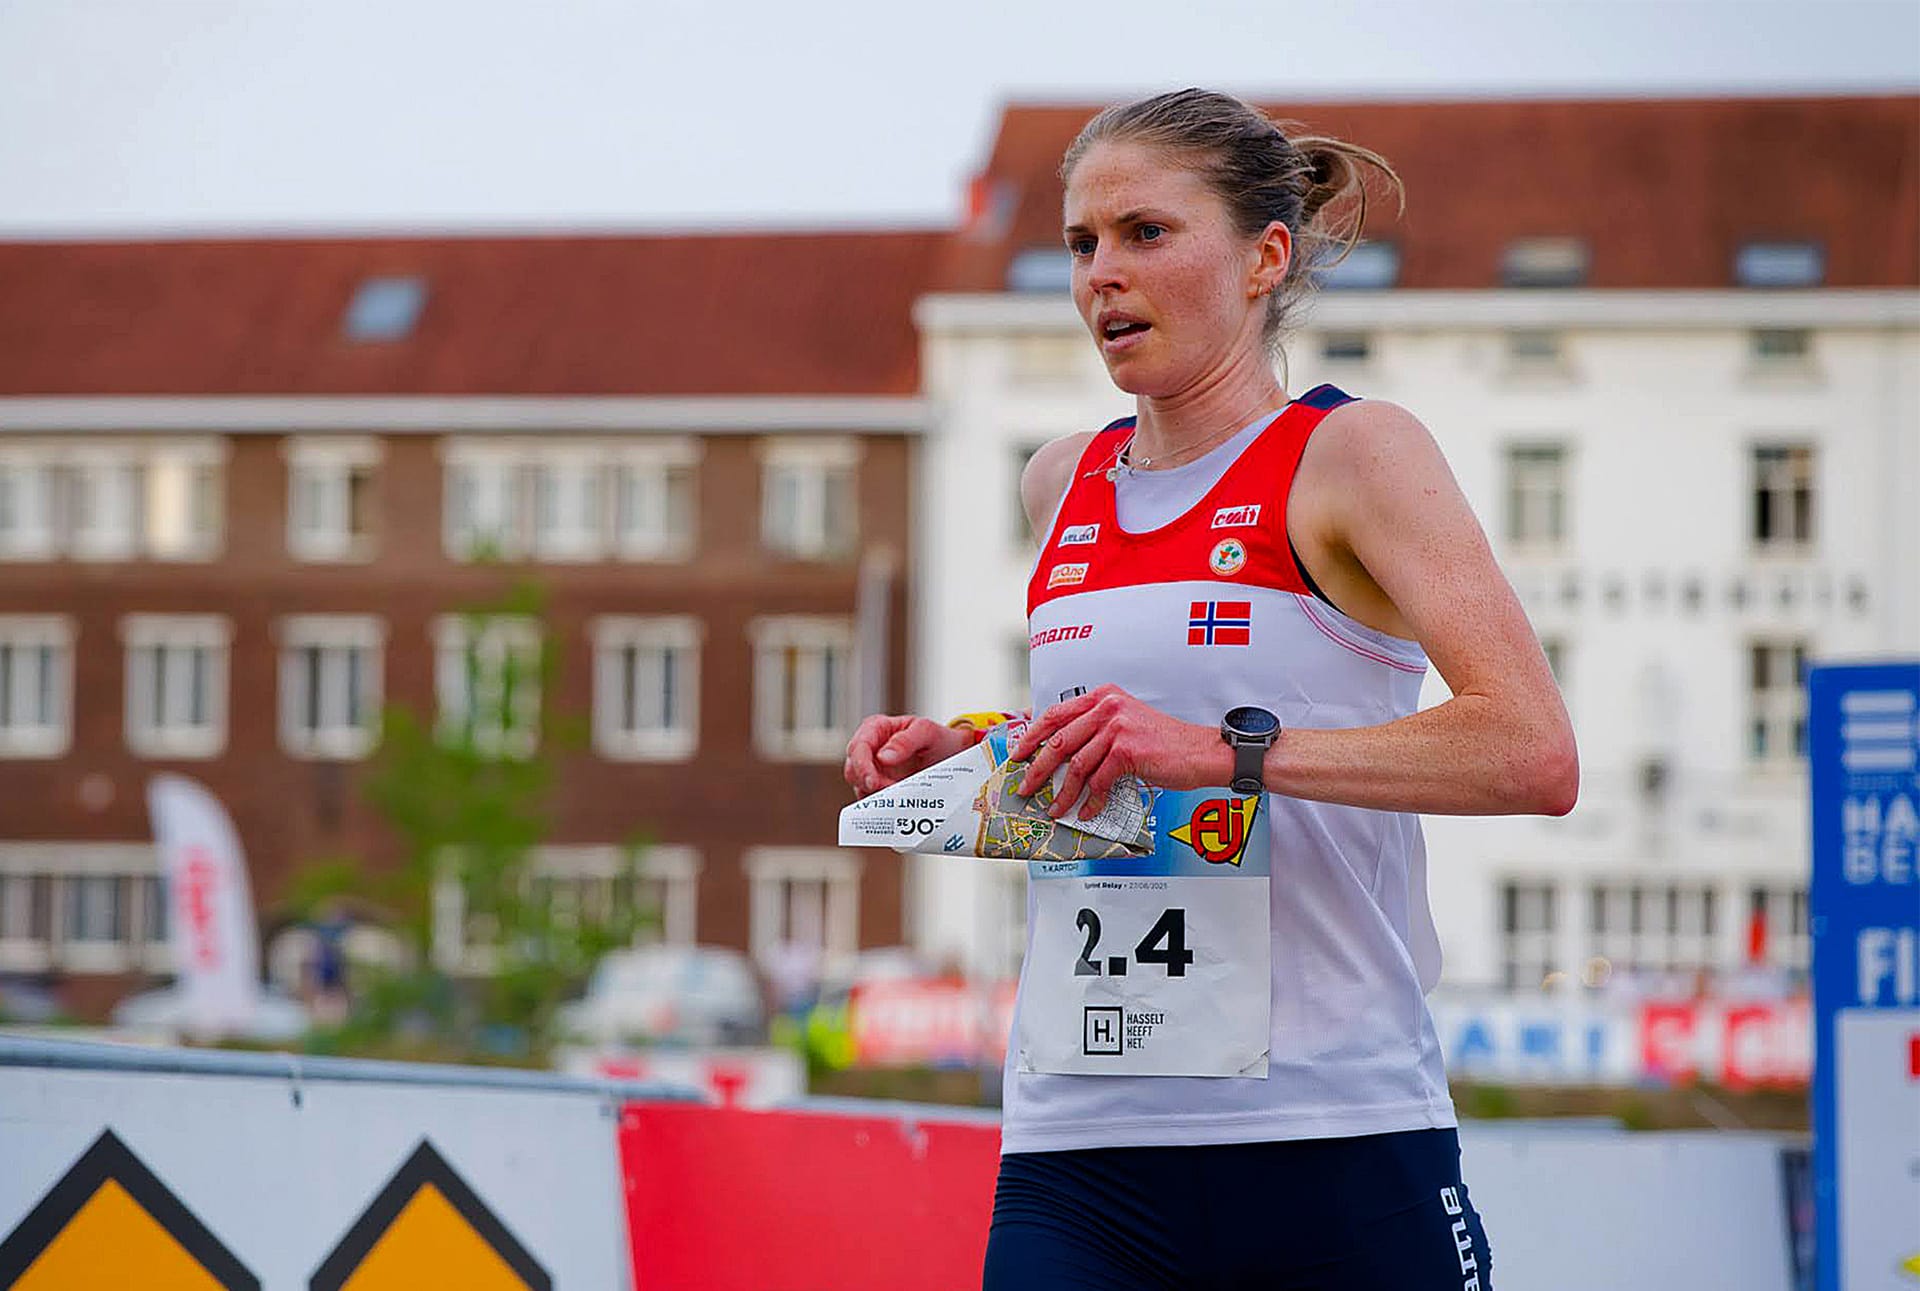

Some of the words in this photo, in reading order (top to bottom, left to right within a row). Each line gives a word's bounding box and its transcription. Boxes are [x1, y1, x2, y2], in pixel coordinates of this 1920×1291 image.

[899, 799, 945, 809] SPRINT
[1074, 908, 1193, 976] 2.4
[1127, 1013, 1164, 1024] HASSELT
[1127, 1026, 1152, 1036] HEEFT
[1127, 1038, 1145, 1049] HET.
